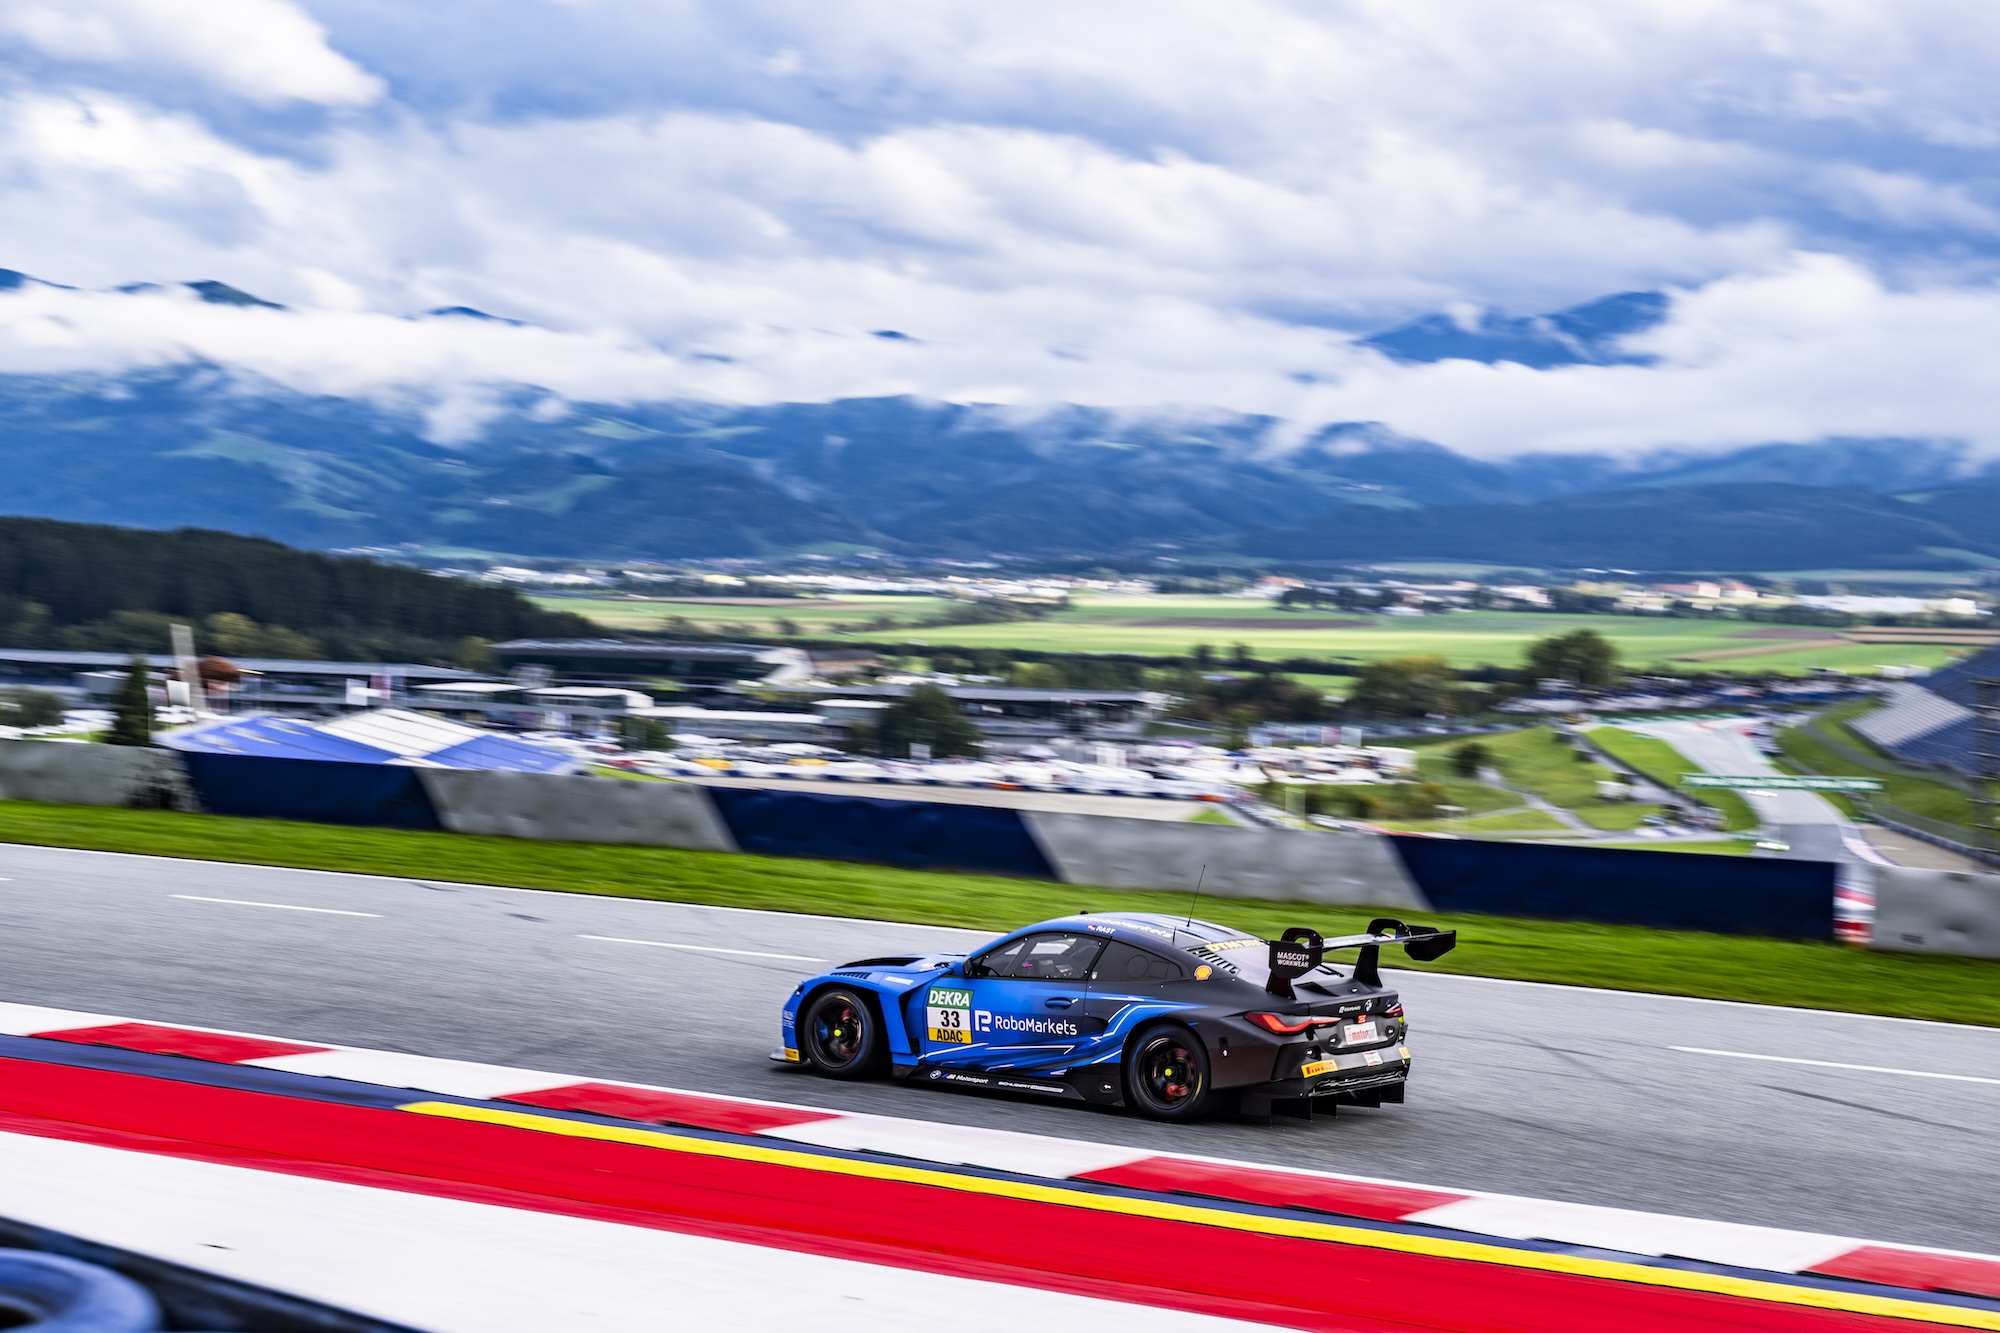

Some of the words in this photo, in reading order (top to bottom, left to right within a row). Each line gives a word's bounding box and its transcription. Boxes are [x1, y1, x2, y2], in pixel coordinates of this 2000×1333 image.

[1096, 925, 1116, 935] RAST
[1277, 959, 1309, 968] WORKWEAR
[928, 990, 970, 1007] DEKRA
[940, 1010, 960, 1028] 33
[995, 1015, 1078, 1036] RoboMarkets
[936, 1028, 963, 1042] ADAC
[956, 1074, 989, 1084] Motorsport
